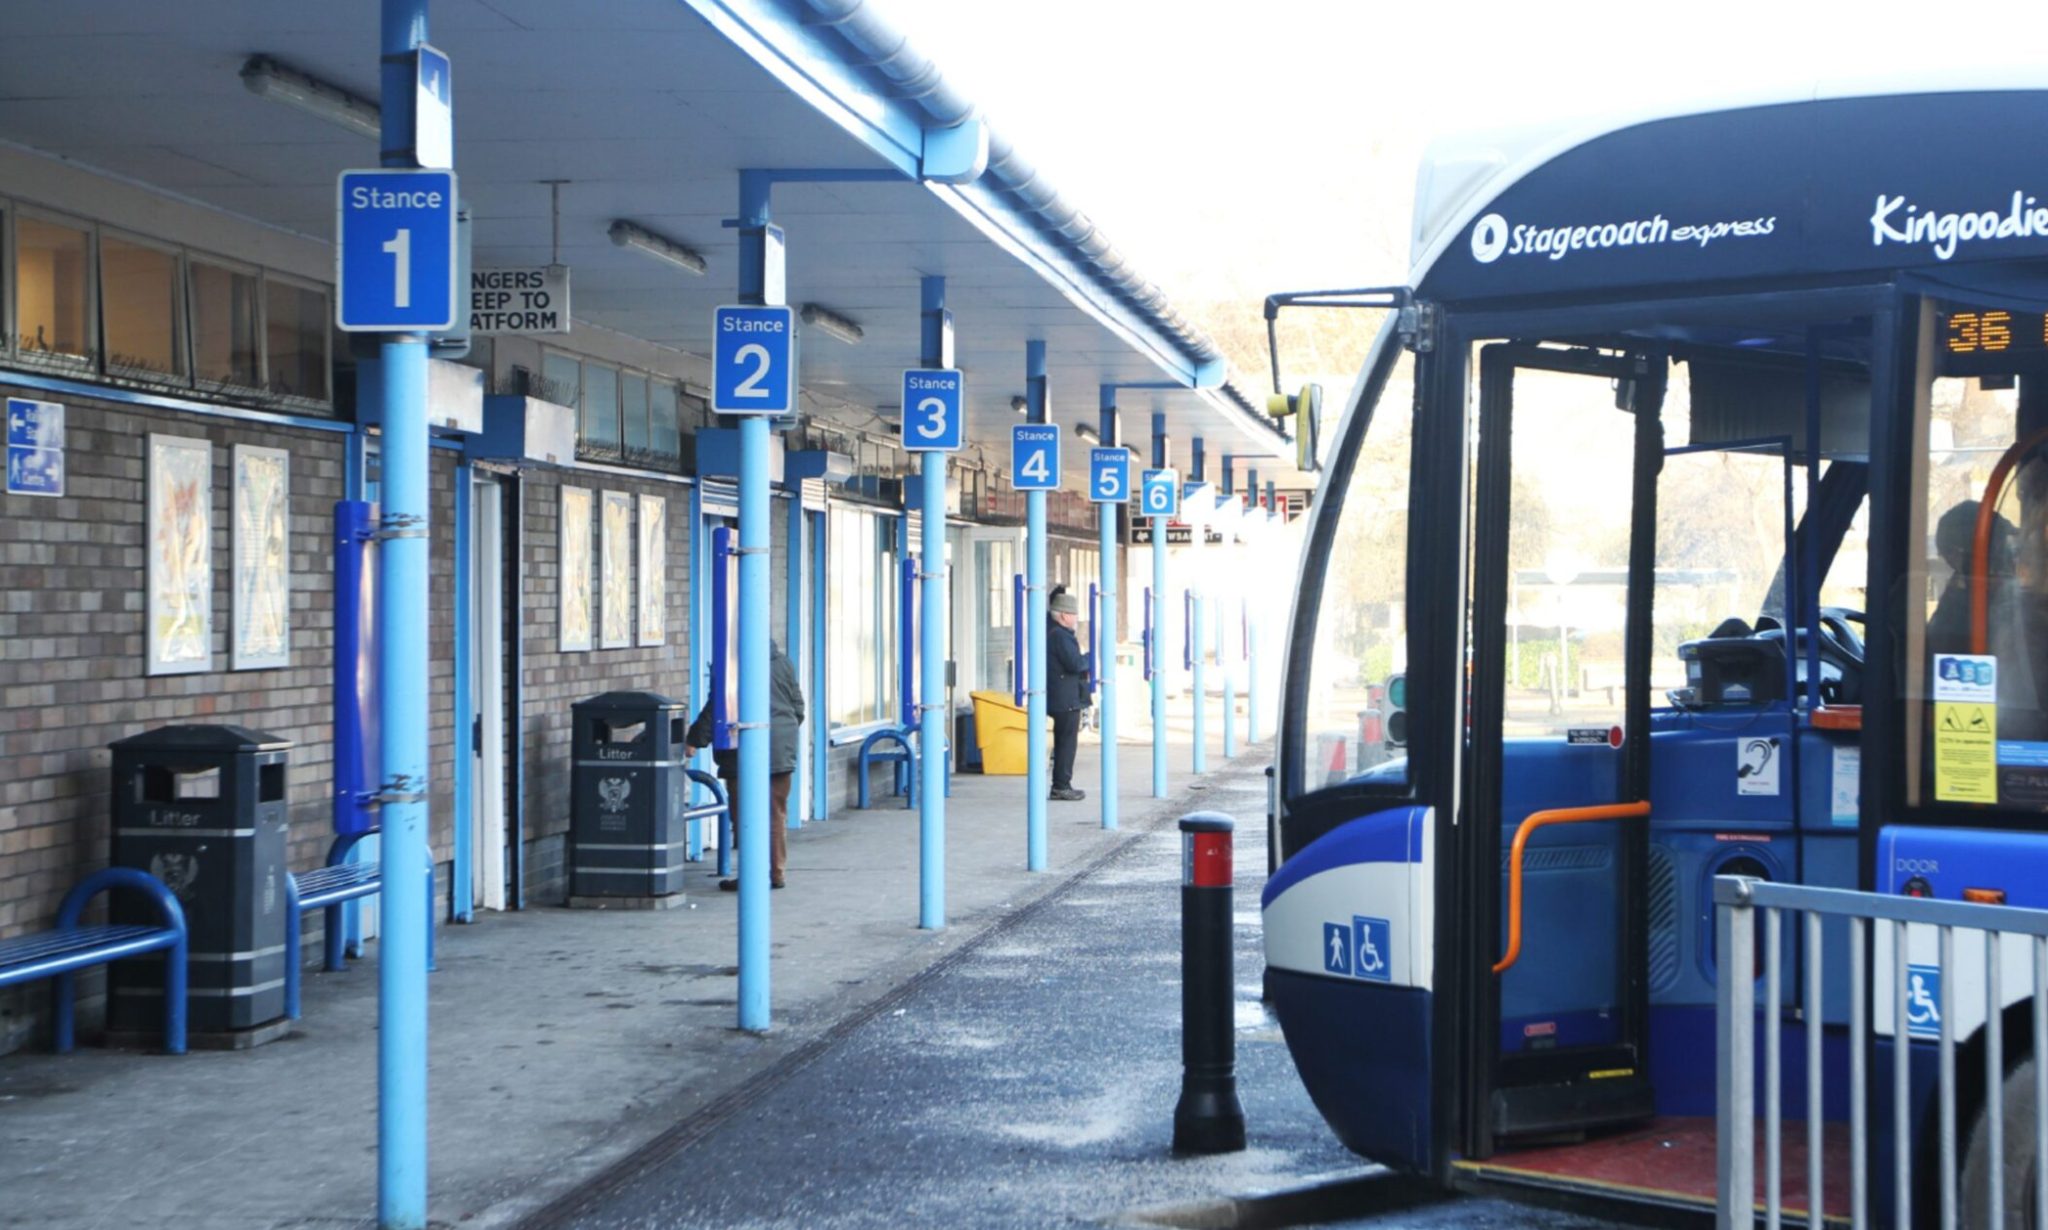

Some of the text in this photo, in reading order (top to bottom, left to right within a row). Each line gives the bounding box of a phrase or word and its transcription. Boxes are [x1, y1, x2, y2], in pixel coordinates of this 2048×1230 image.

[352, 186, 442, 209] Stance
[1870, 190, 2048, 260] Kingoodie
[1508, 214, 1777, 260] Stagecoach express
[382, 228, 411, 308] 1
[472, 272, 544, 289] NGERS
[472, 291, 550, 310] EEP TO
[471, 312, 557, 330] ATFORM
[723, 316, 784, 332] Stance
[1949, 311, 2011, 352] 36
[734, 343, 771, 398] 2
[909, 377, 956, 390] Stance
[917, 397, 947, 439] 3
[1016, 430, 1055, 441] Stance
[1021, 449, 1050, 483] 4
[1094, 453, 1126, 462] Stance
[1099, 467, 1120, 496] 5
[1150, 484, 1168, 510] 6
[599, 747, 633, 760] Litter
[151, 810, 201, 827] Litter
[1896, 859, 1939, 873] DOOR
